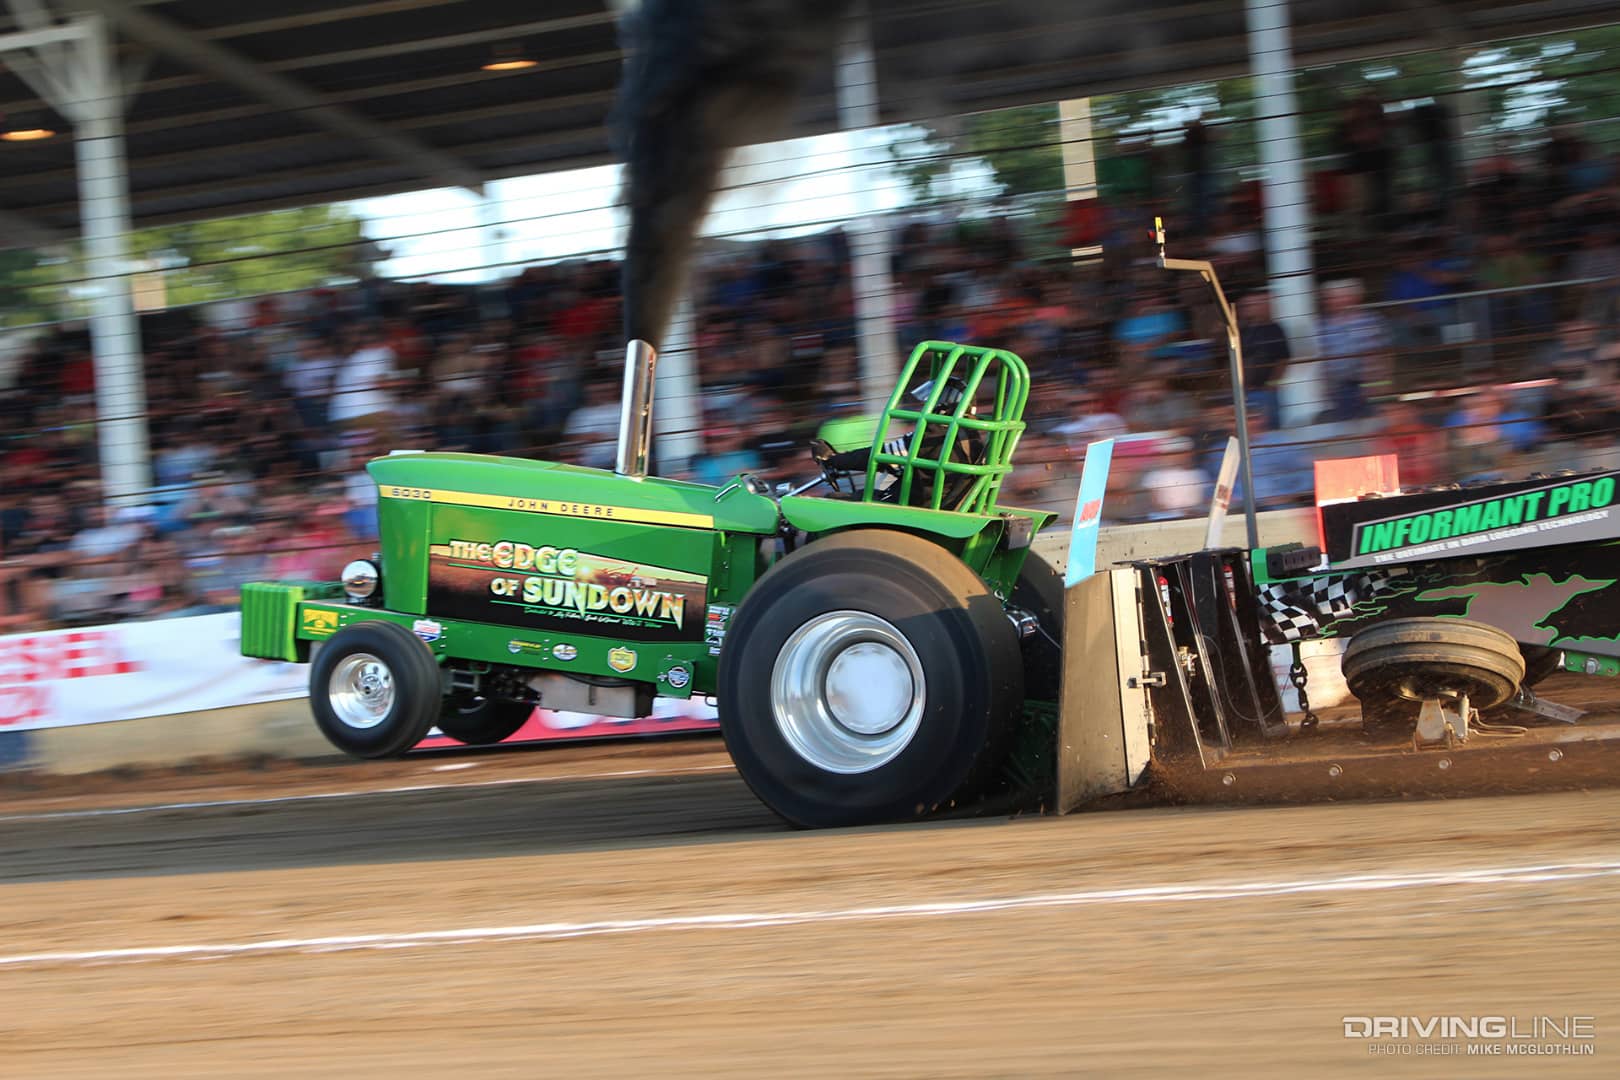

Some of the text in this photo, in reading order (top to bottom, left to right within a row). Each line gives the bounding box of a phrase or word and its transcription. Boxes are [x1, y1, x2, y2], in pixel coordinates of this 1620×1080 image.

[508, 499, 614, 517] JOHN DEERE
[1359, 477, 1616, 554] INFORMANT PRO
[449, 540, 579, 576] THE EDGE
[490, 577, 520, 597] OF
[522, 577, 686, 631] SUNDOWN
